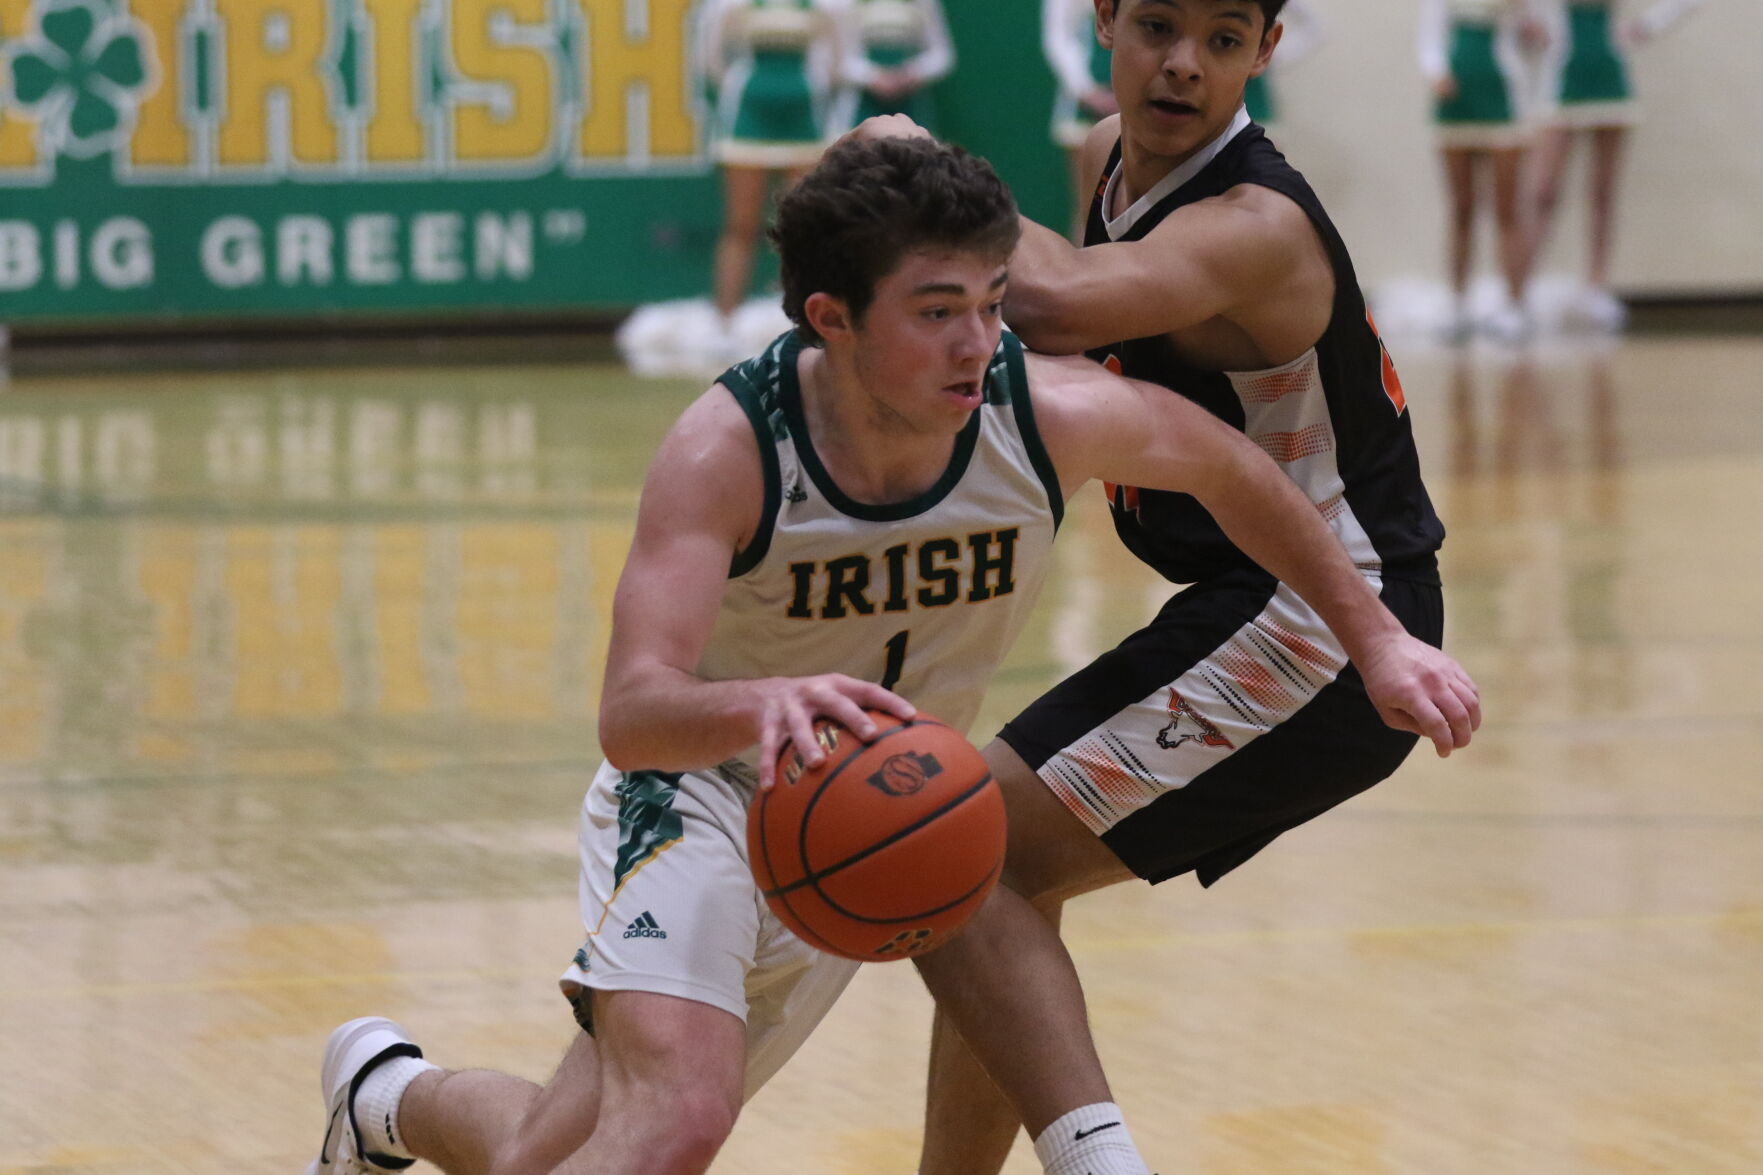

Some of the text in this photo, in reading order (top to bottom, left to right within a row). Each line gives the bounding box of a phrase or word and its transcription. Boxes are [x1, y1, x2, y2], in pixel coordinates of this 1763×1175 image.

[0, 217, 154, 291] BIG
[785, 526, 1020, 621] IRISH
[882, 629, 910, 690] 1
[623, 927, 667, 940] adidas
